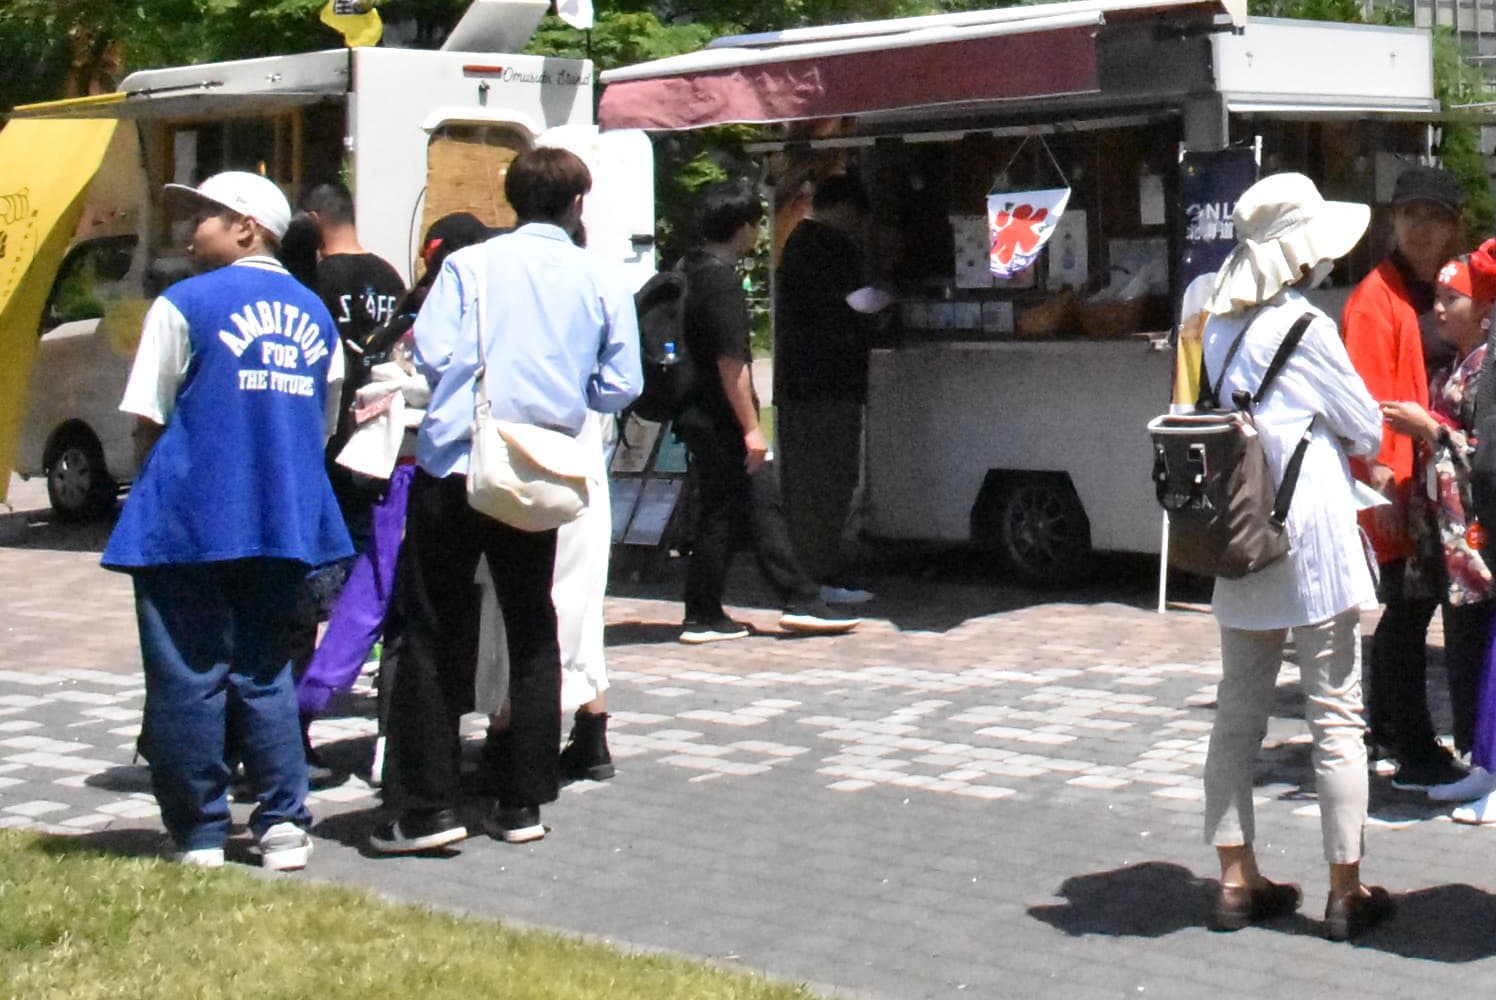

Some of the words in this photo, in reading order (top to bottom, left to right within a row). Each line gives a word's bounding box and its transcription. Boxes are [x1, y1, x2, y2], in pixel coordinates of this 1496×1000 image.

[218, 300, 329, 367] AMBITION
[261, 340, 298, 369] FOR
[237, 369, 269, 391] THE
[270, 370, 315, 397] FUTURE
